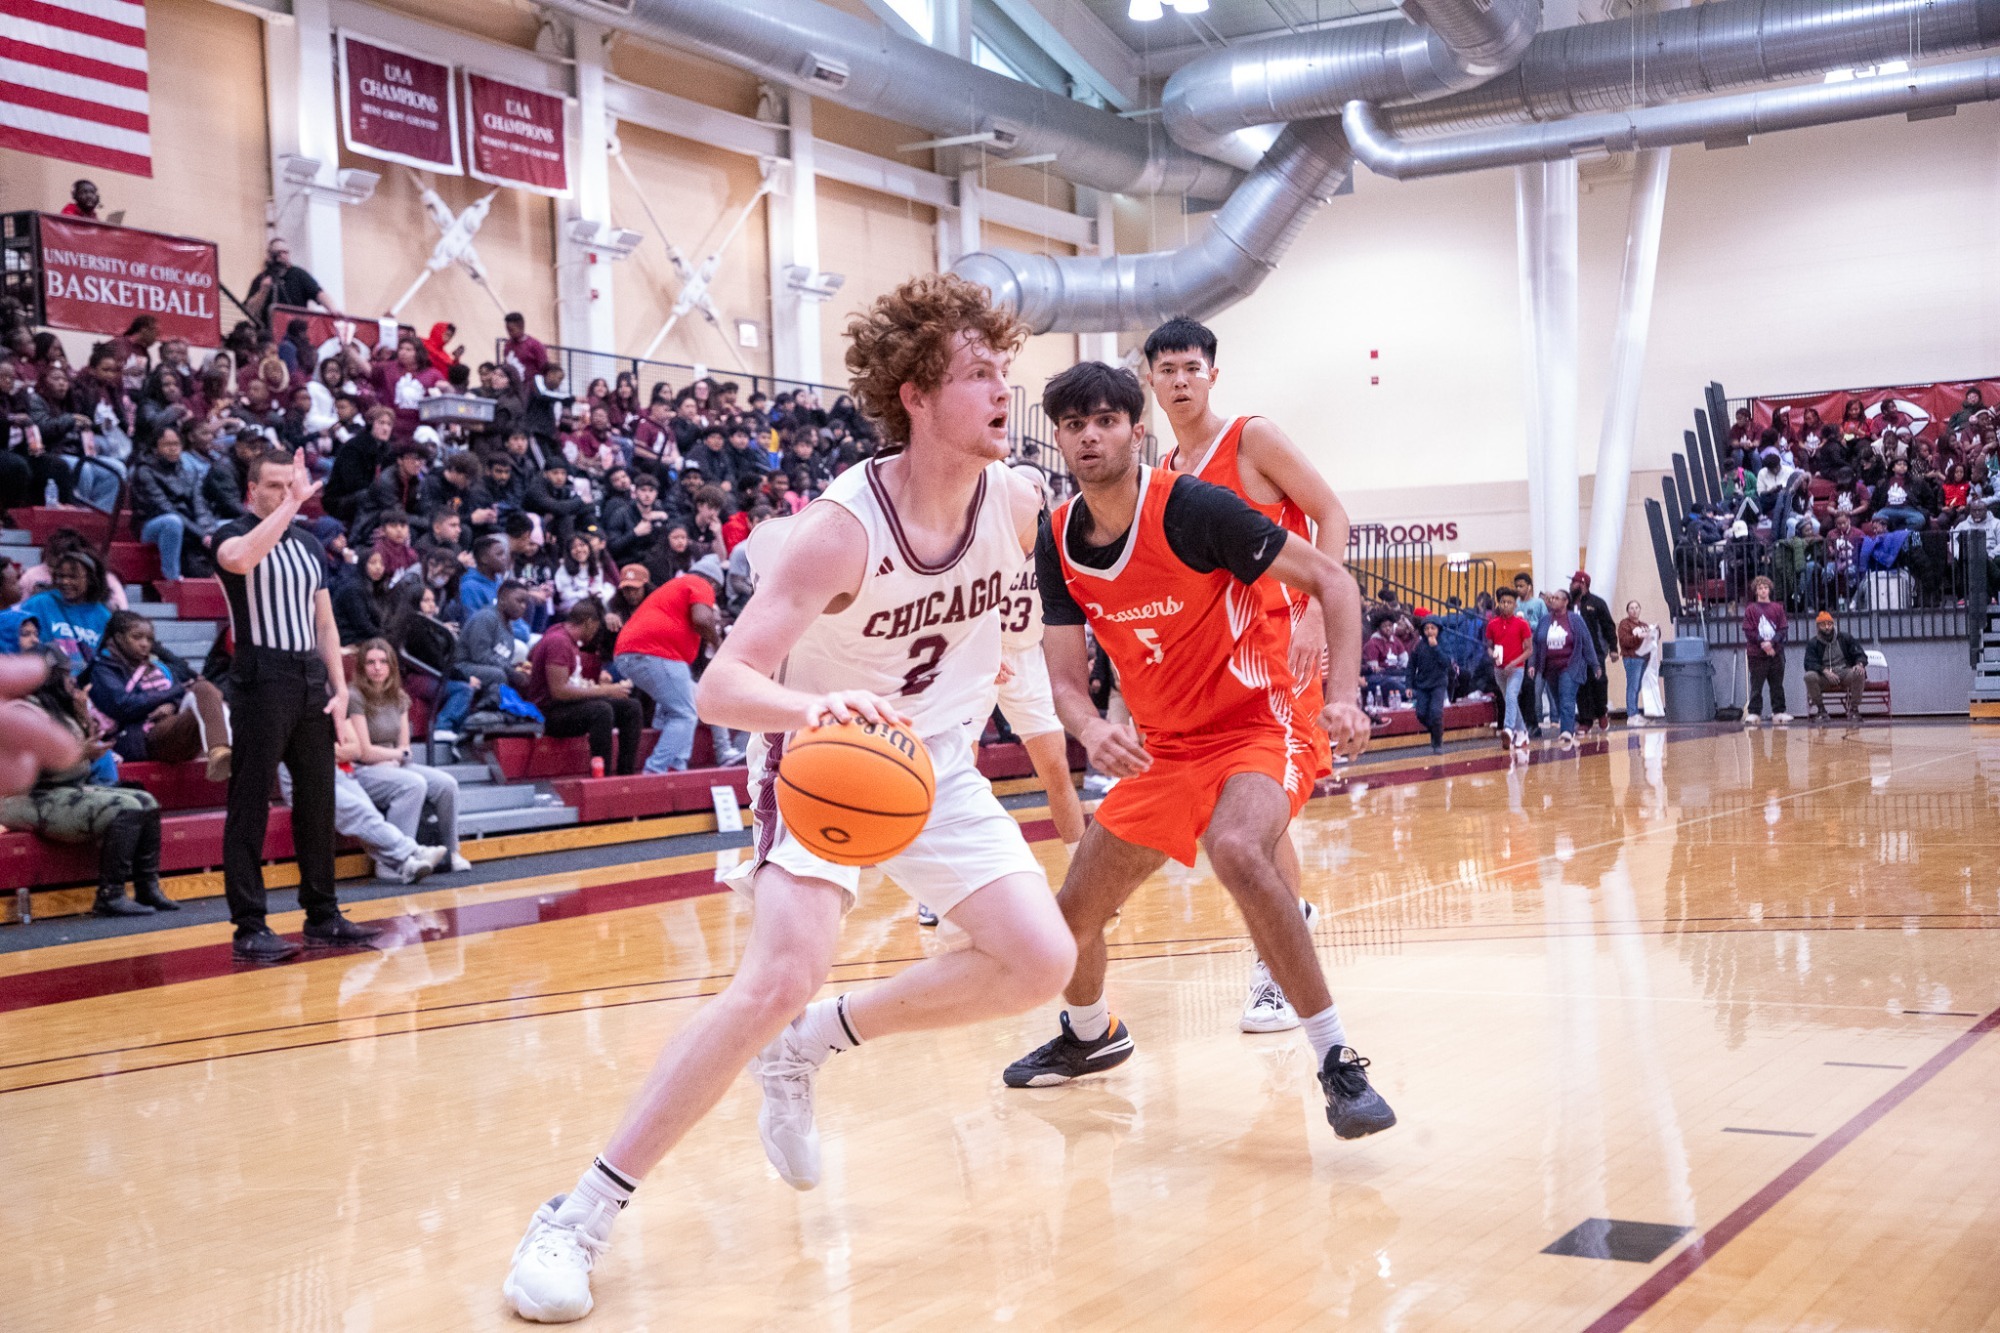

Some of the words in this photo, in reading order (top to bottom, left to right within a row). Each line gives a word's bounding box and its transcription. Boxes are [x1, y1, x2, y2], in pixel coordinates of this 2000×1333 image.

[360, 77, 439, 114] CHAMPIONS
[482, 112, 555, 144] CHAMPIONS
[43, 247, 128, 276] UNIVERSITY
[130, 262, 148, 278] OF
[150, 265, 213, 289] CHICAGO
[47, 269, 214, 319] BASKETBALL
[1347, 522, 1458, 546] STROOMS
[862, 570, 1002, 640] CHICAGO
[1000, 595, 1033, 632] 23
[901, 633, 949, 697] 2
[1133, 628, 1165, 666] 5
